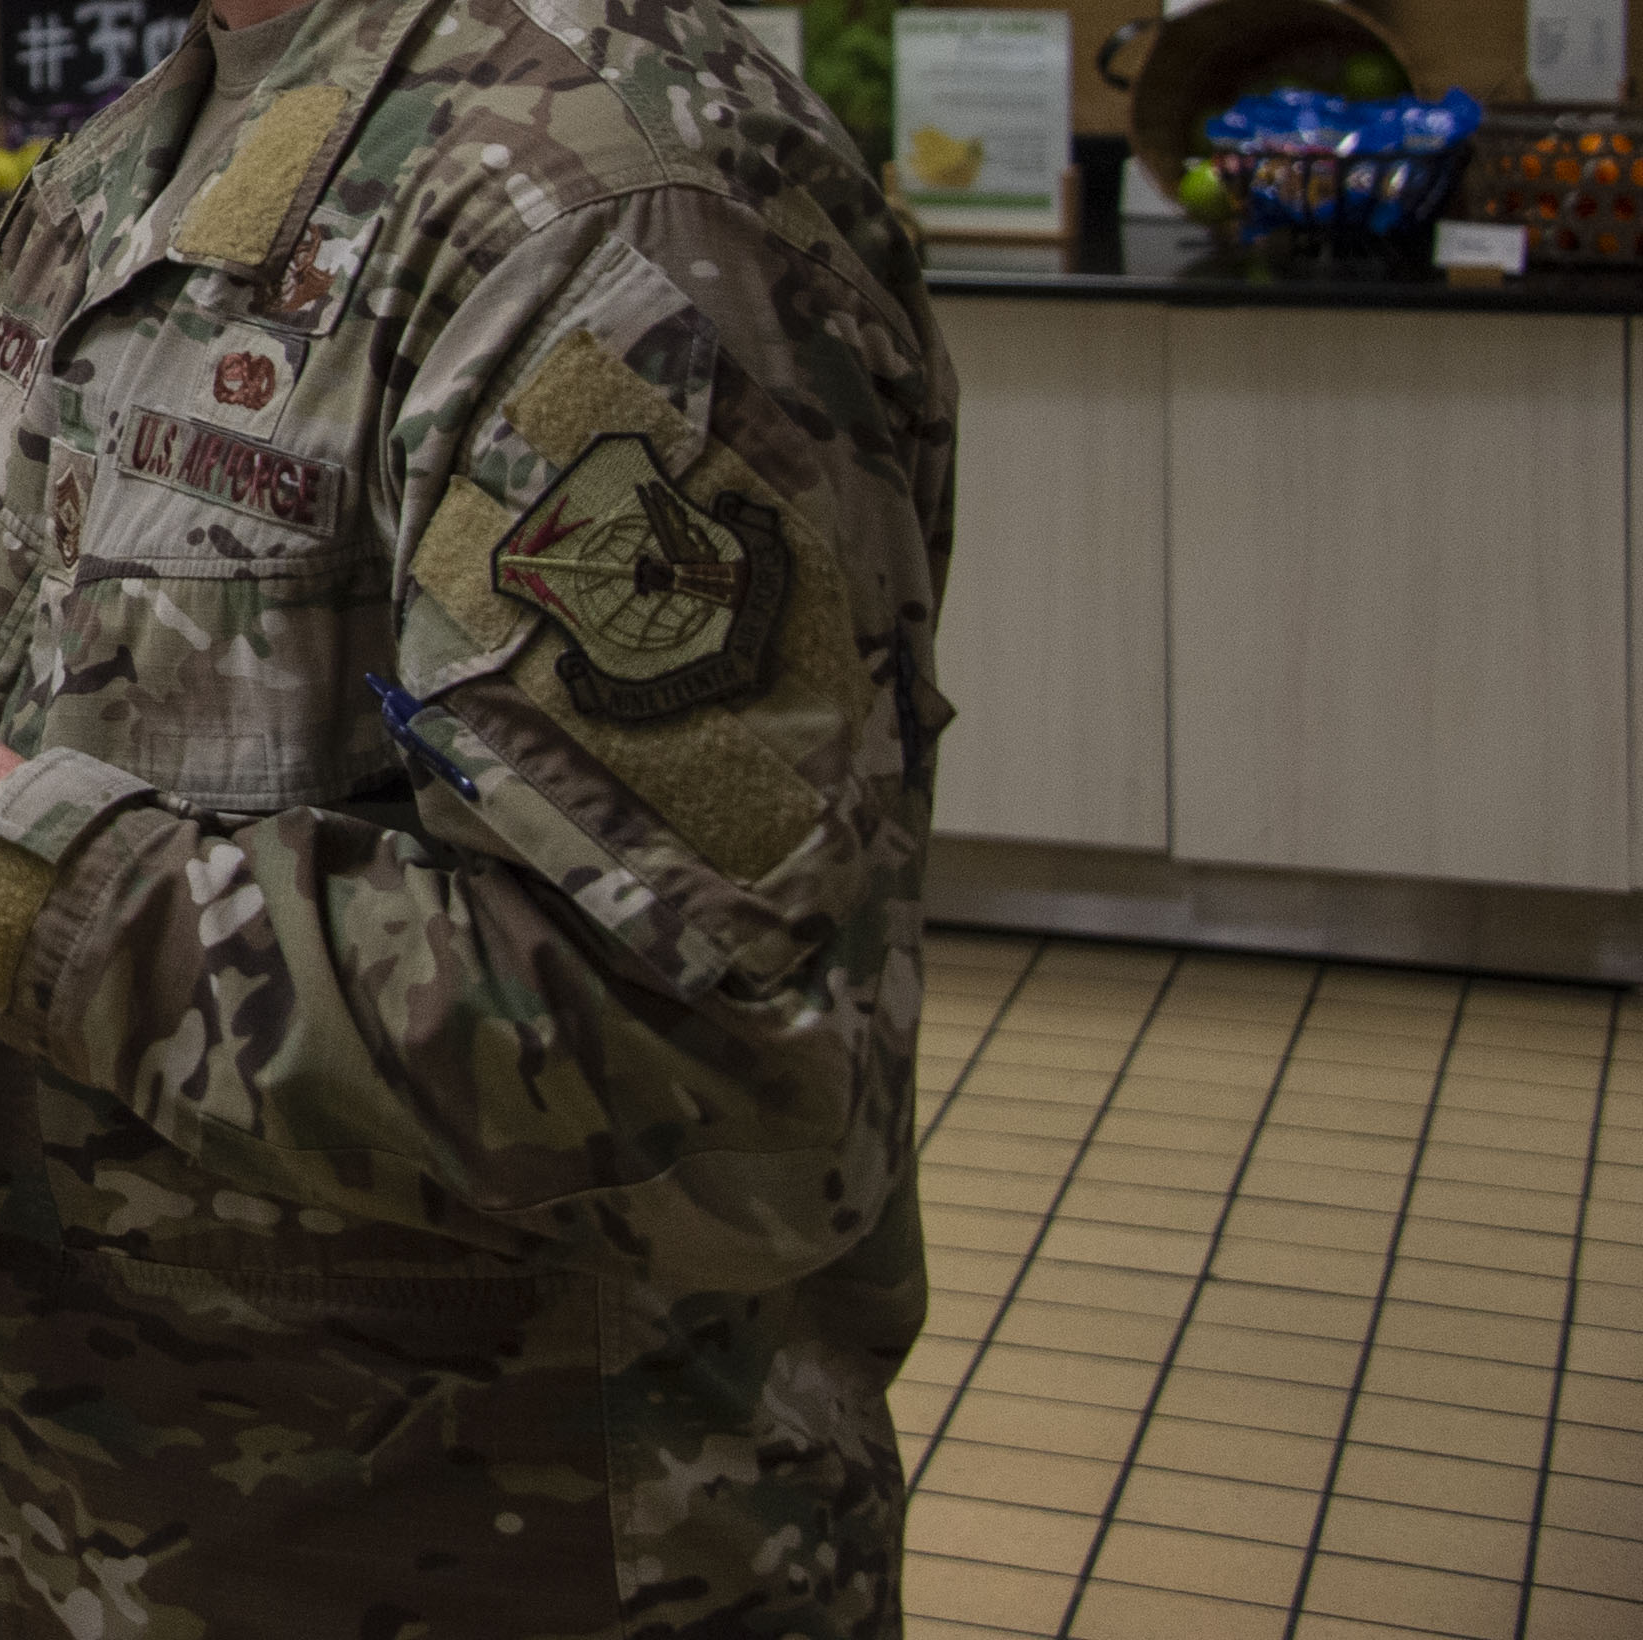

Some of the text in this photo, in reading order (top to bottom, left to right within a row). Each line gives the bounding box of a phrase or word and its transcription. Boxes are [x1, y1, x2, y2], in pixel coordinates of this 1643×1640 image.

[131, 415, 321, 525] U.S. AIR FORCE
